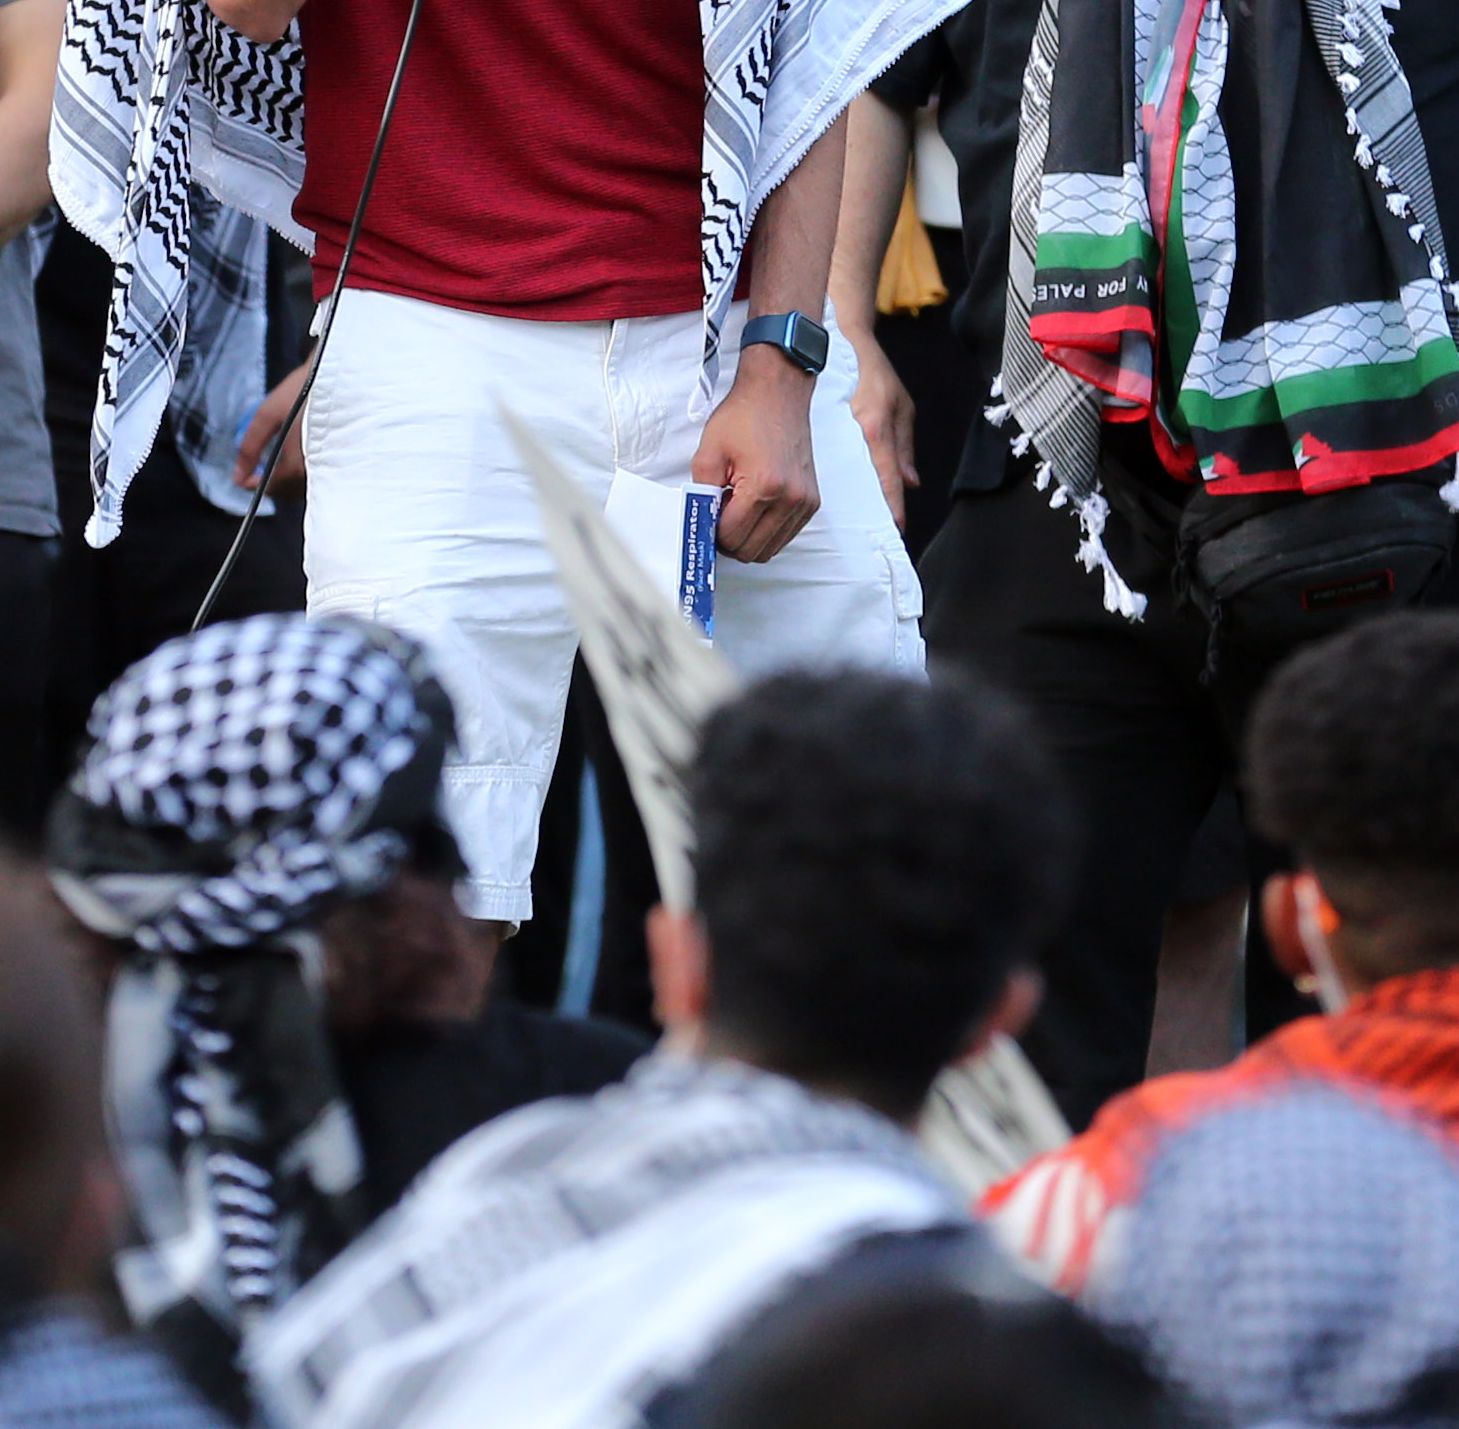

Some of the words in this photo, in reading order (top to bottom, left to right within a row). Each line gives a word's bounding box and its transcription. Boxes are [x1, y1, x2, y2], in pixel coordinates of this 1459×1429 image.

[1097, 276, 1127, 298] FOR
[685, 499, 699, 581] Respirator
[697, 541, 706, 568] Mask)
[697, 569, 705, 592] (Face
